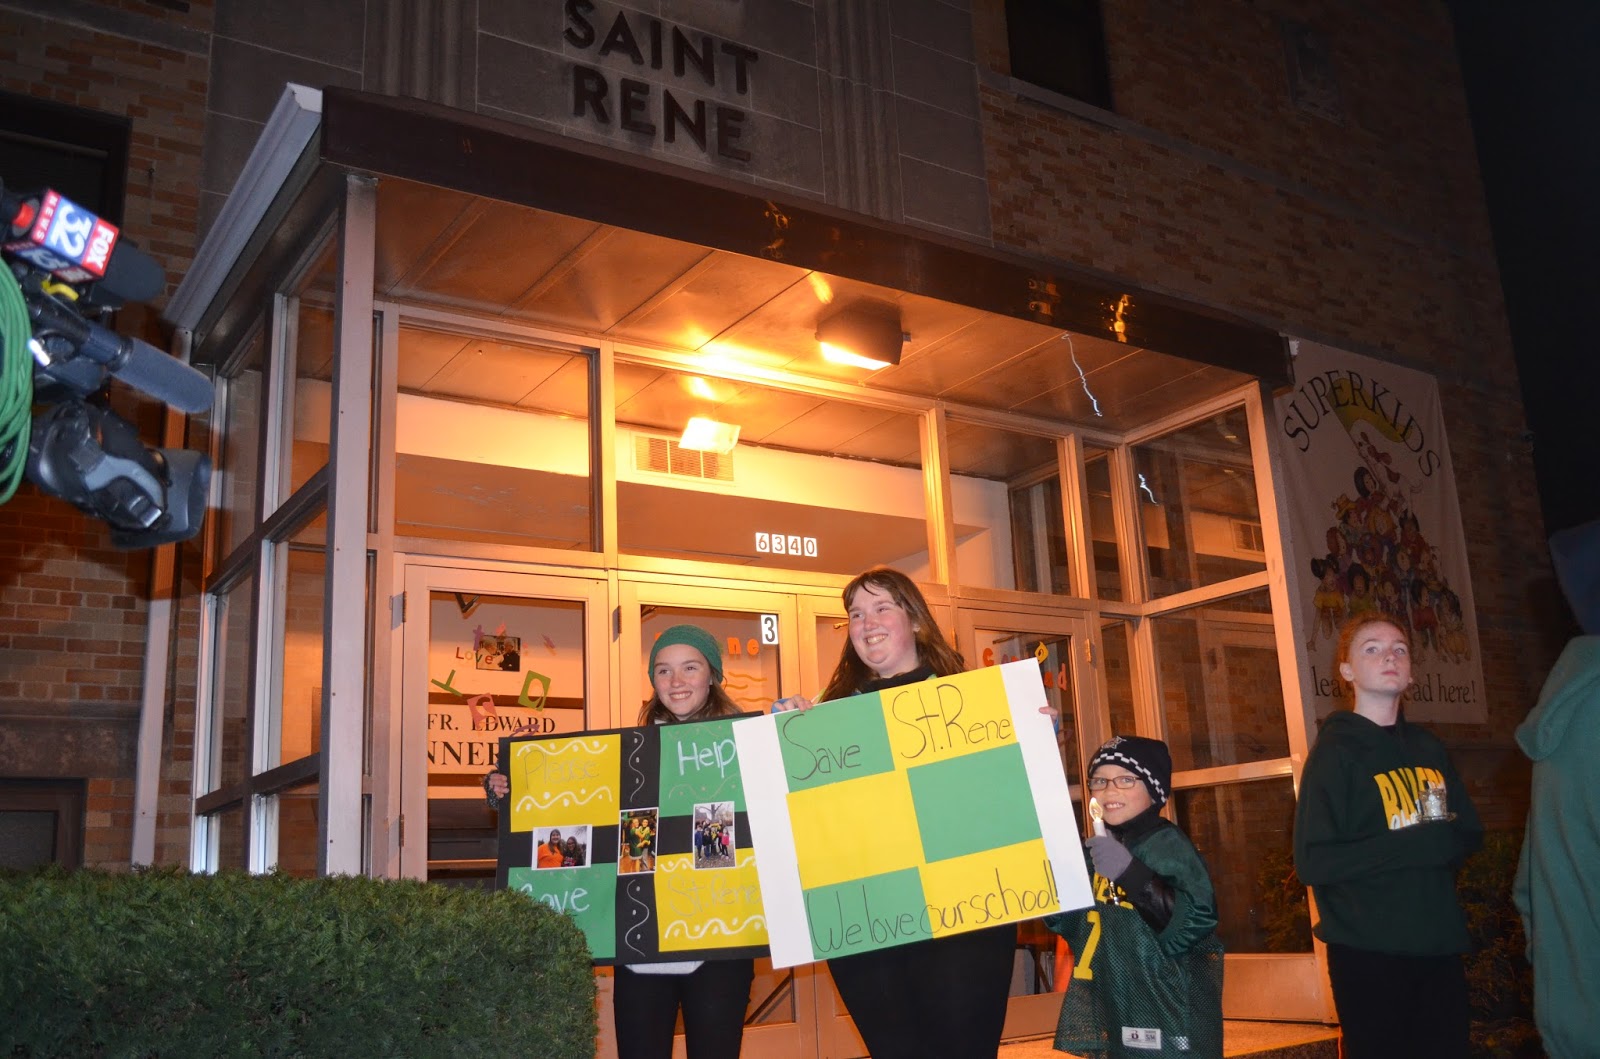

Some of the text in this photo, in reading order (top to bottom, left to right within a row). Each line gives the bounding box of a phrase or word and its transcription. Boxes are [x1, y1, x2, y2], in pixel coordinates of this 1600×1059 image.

[564, 0, 759, 95] SAINT
[573, 65, 751, 163] RENE
[36, 195, 59, 241] NEWS
[50, 204, 93, 258] 32
[85, 224, 115, 271] FOX
[1284, 370, 1441, 477] SUPERKIDS
[757, 534, 816, 556] 6340
[763, 616, 777, 643] 3
[456, 647, 494, 665] Love
[1312, 666, 1343, 697] lea
[1438, 674, 1477, 704] here!
[428, 713, 459, 730] FR.
[524, 738, 737, 790] Please Help
[782, 713, 862, 781] Save
[806, 890, 862, 953] We
[862, 884, 915, 944] love
[919, 901, 967, 934] our
[969, 859, 1061, 924] school!
